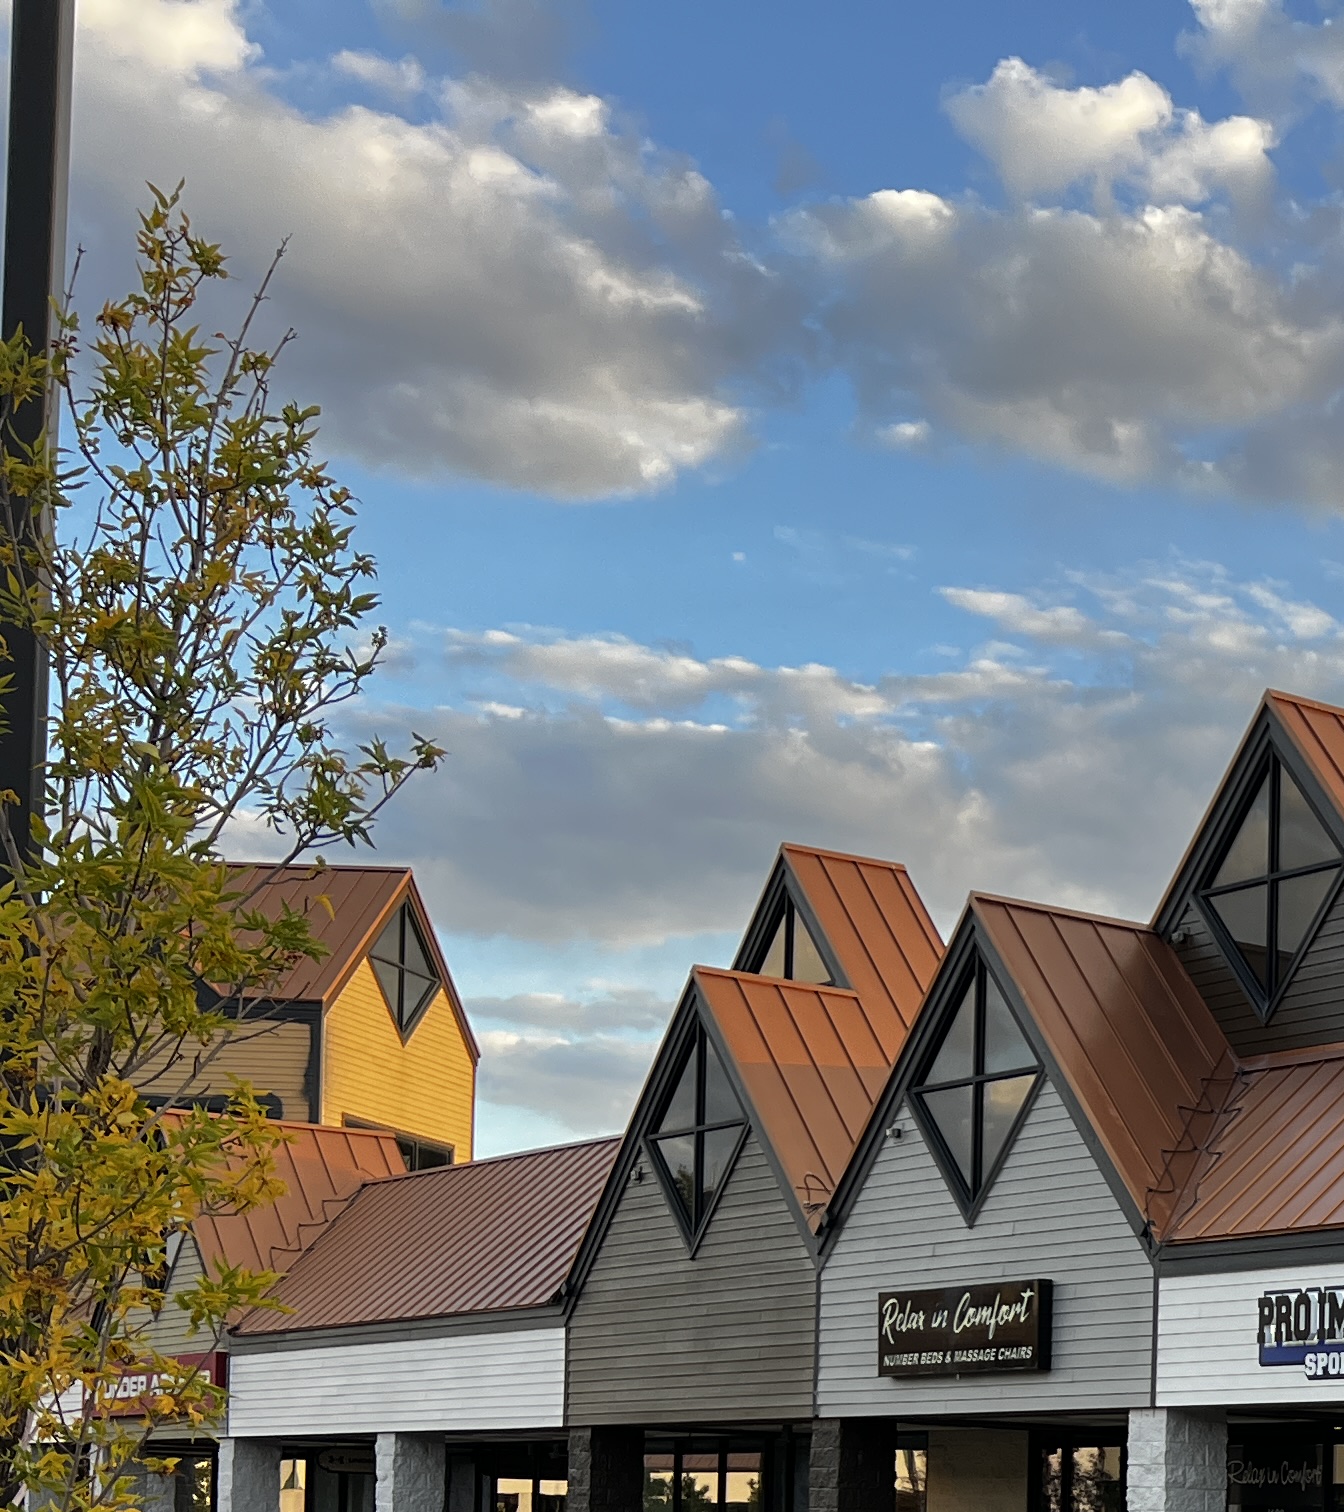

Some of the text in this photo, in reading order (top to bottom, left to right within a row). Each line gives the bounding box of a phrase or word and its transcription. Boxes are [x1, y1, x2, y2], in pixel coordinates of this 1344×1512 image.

[882, 1288, 1035, 1344] Relax in Comfort
[1257, 1292, 1311, 1344] PRO
[883, 1346, 1033, 1367] NUMBER BEDS & MASSAGE CHAIRS
[1228, 1460, 1323, 1492] Relax in Comfort
